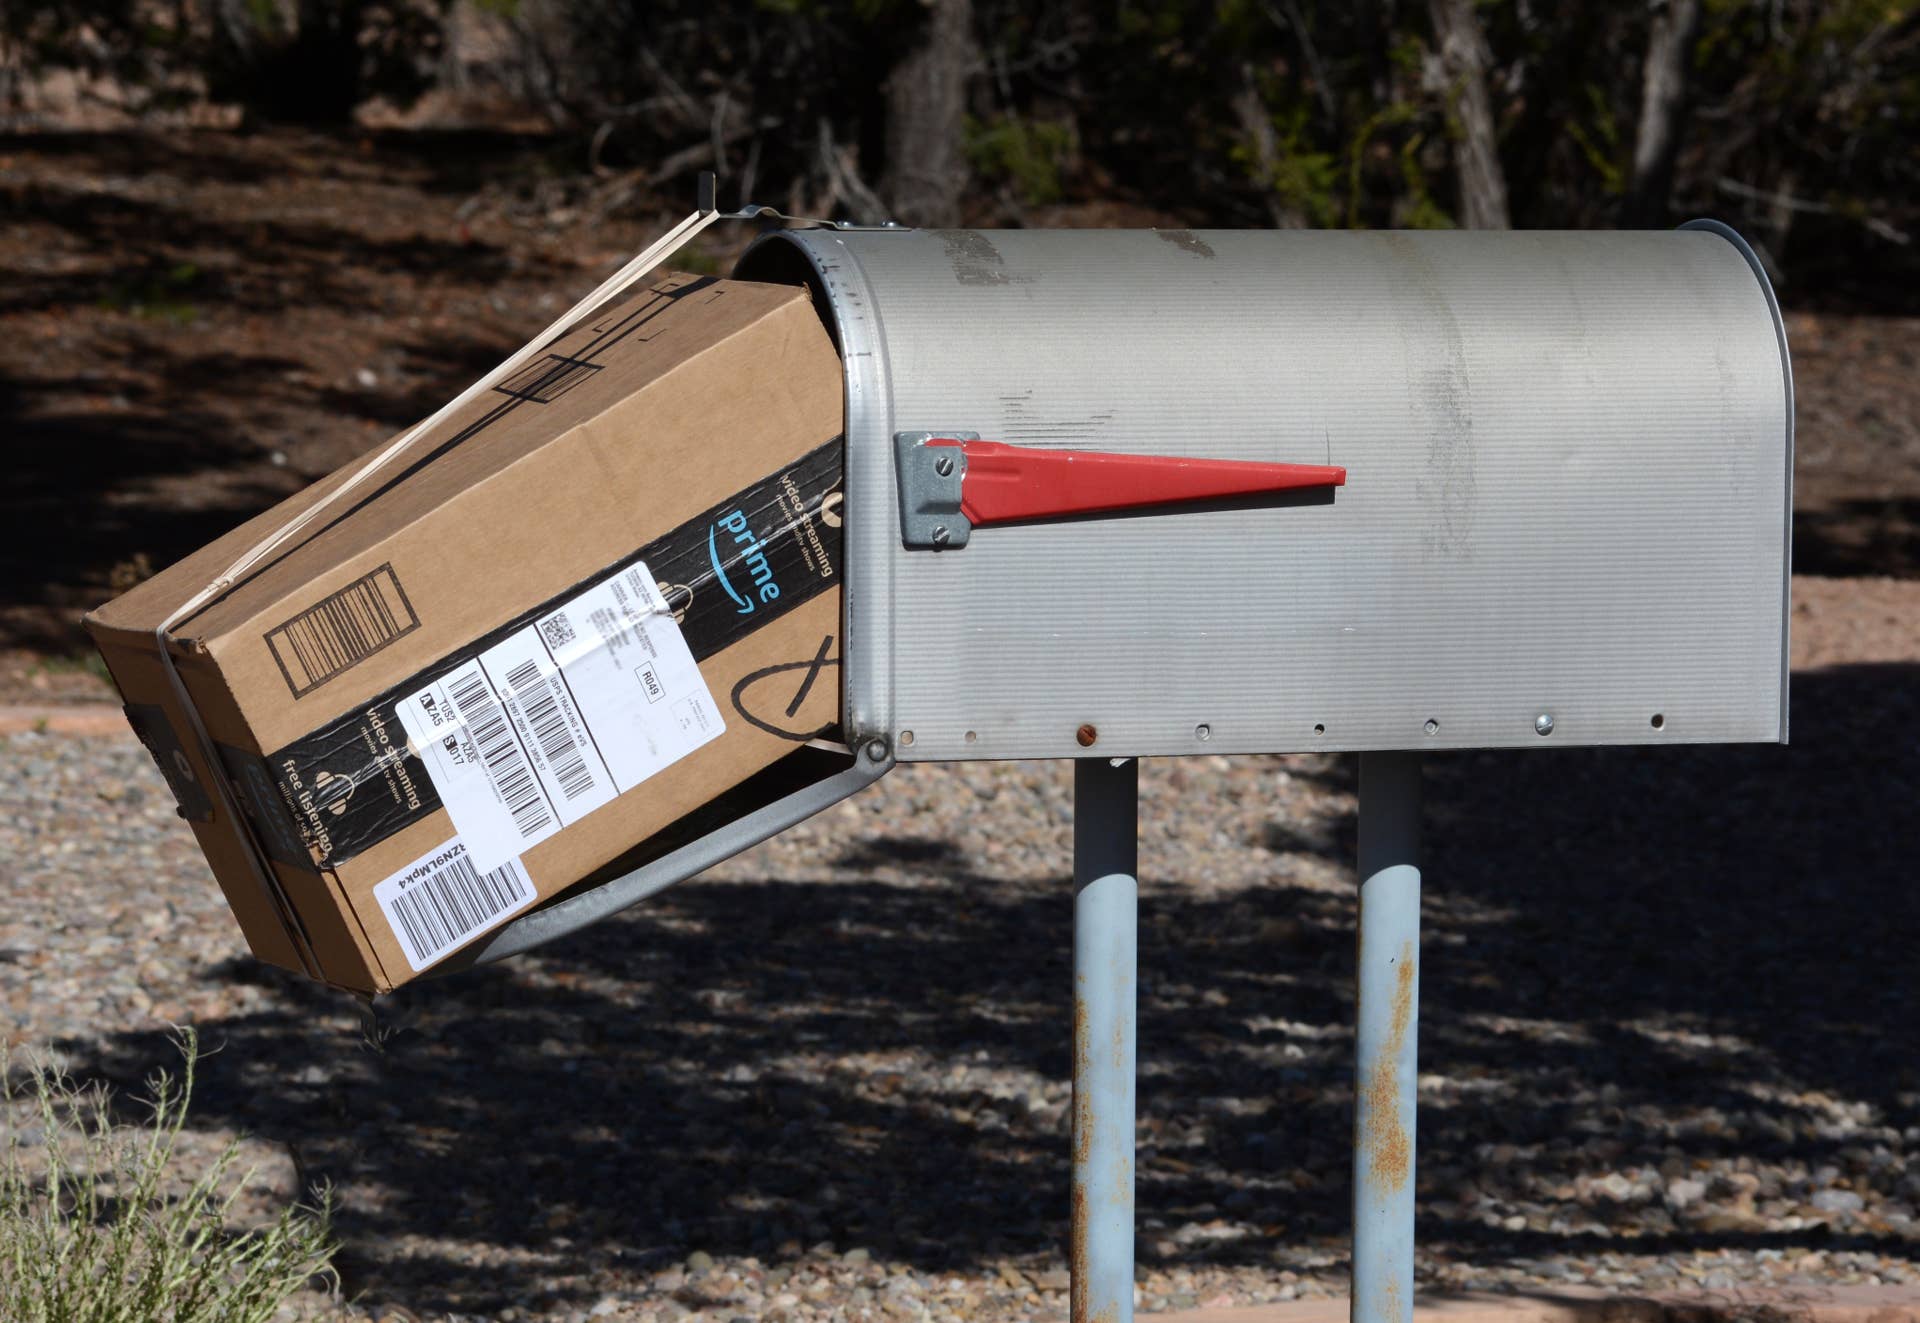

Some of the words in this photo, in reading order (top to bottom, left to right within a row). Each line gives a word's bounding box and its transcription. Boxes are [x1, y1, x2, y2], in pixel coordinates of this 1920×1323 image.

[717, 509, 782, 604] prime
[775, 493, 793, 522] movies
[800, 545, 816, 571] shows
[779, 472, 805, 513] video
[796, 510, 835, 578] streaming
[437, 699, 455, 723] TUS2
[548, 676, 562, 696] USPS
[558, 695, 578, 728] TRACKING
[640, 670, 660, 697] R049
[359, 725, 379, 754] movies
[381, 769, 391, 780] tv
[386, 778, 403, 804] shows
[364, 705, 391, 745] video
[383, 743, 424, 811] streaming
[459, 740, 477, 763] AZA5
[277, 779, 299, 812] millions
[280, 758, 305, 791] free
[296, 790, 337, 855] listening
